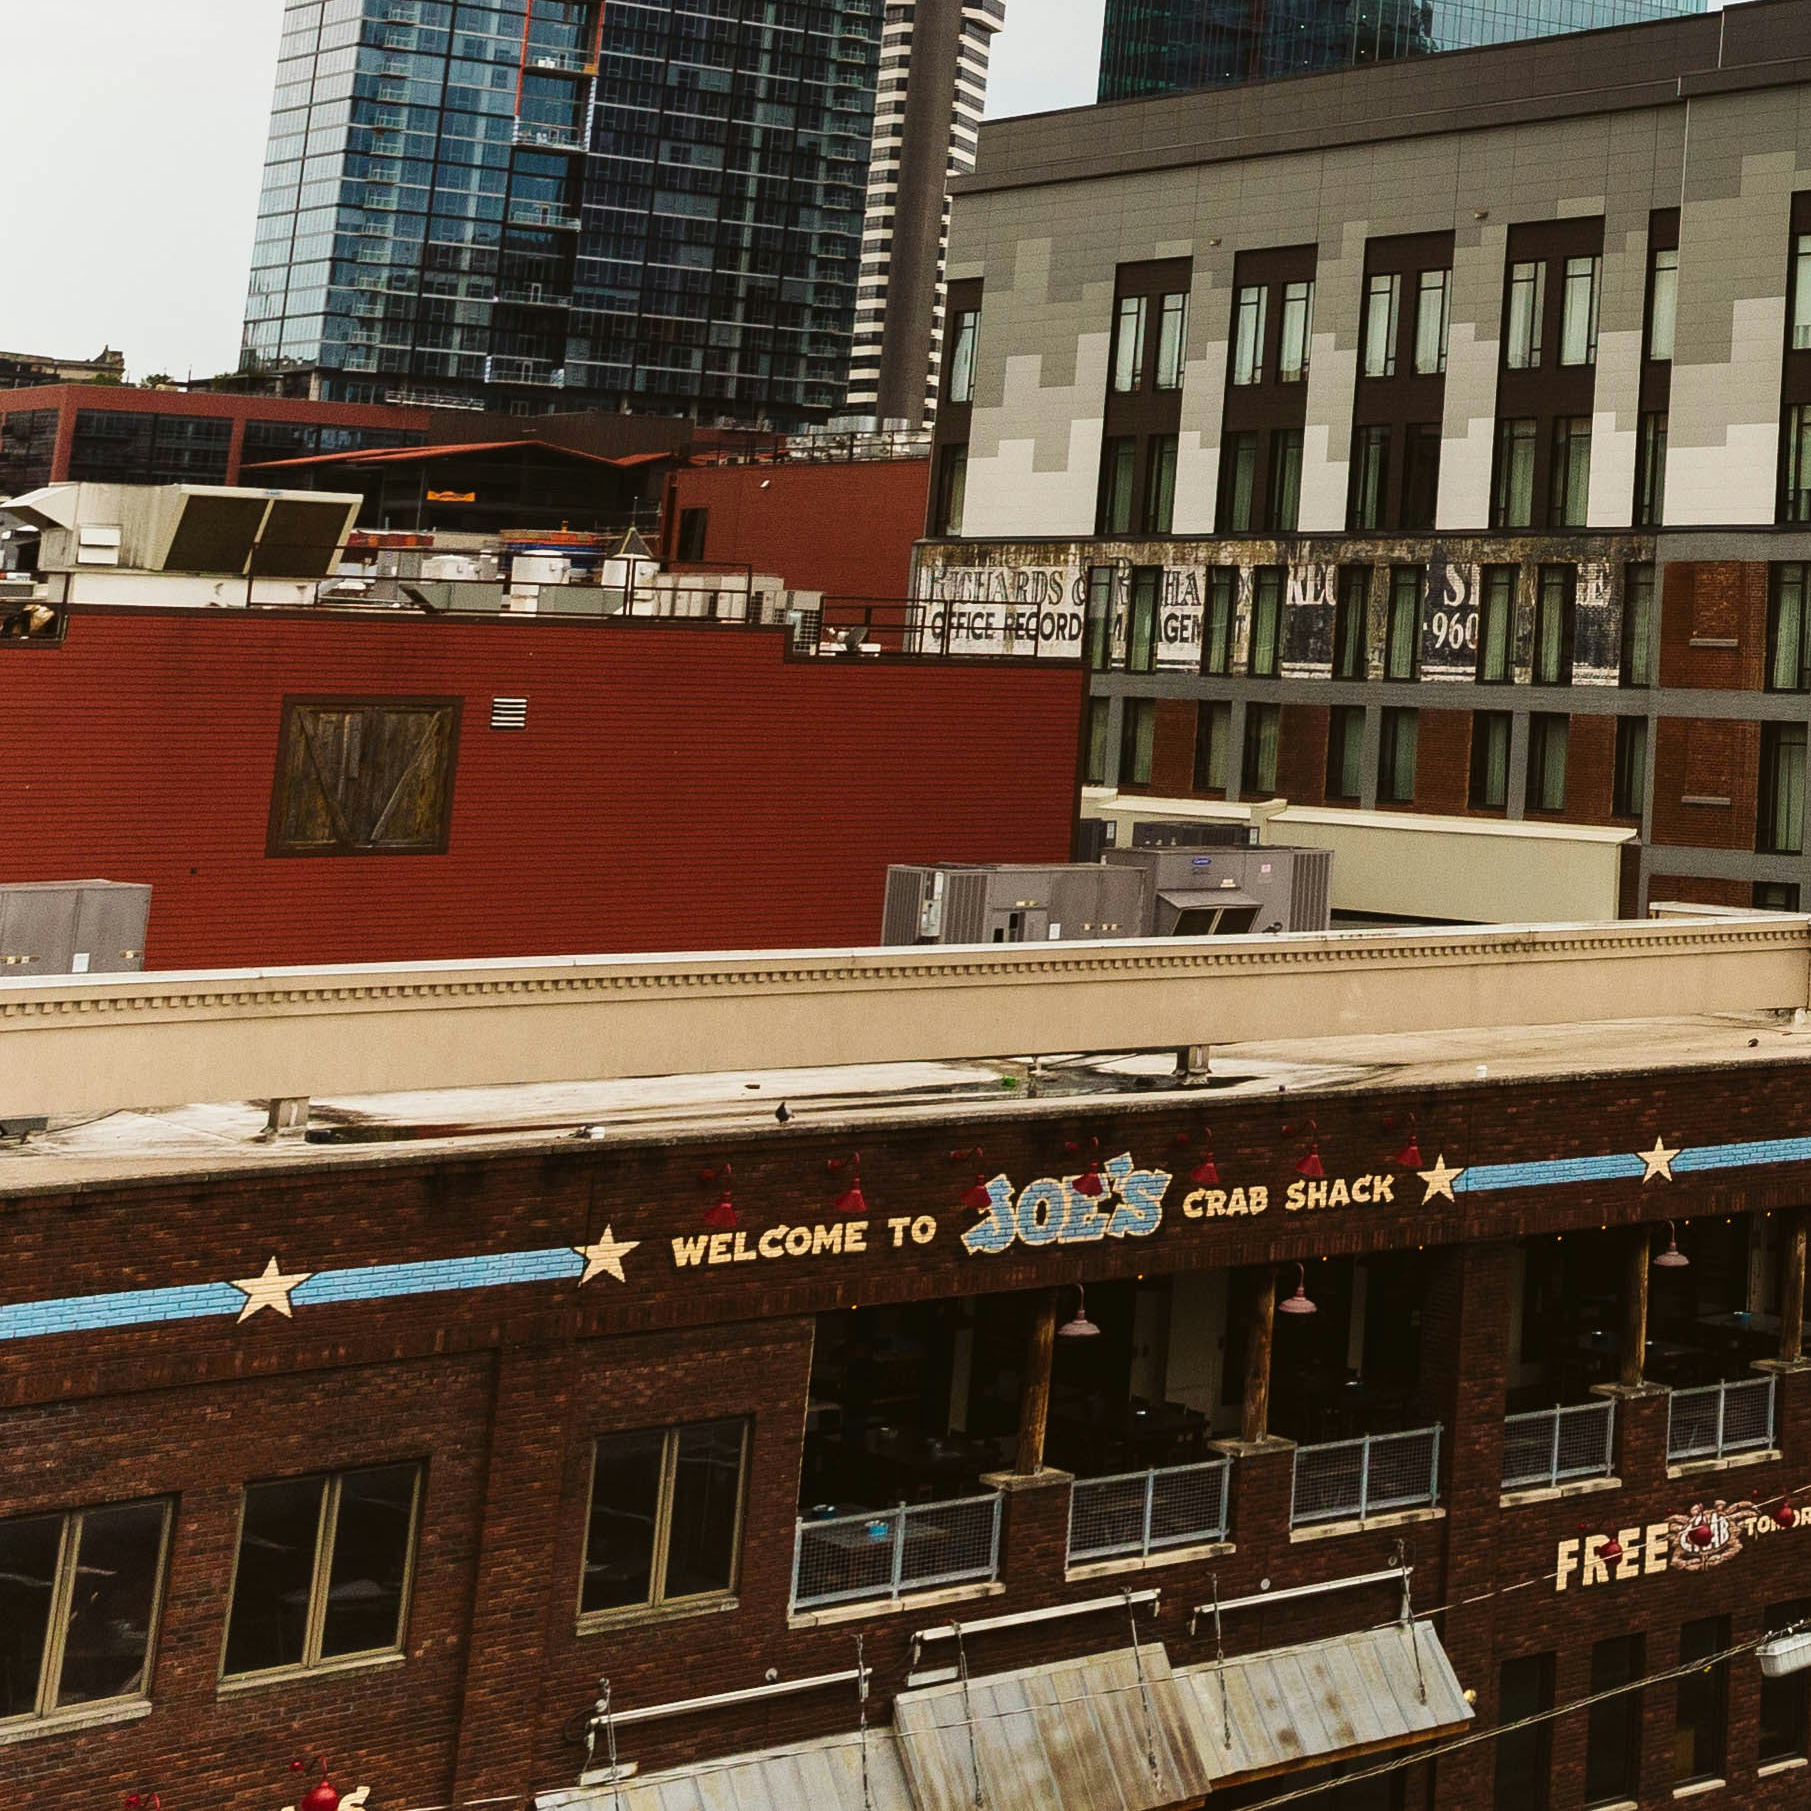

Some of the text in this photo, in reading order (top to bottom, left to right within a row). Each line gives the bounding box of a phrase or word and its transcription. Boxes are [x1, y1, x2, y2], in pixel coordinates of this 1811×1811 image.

[931, 560, 1063, 606] RICHARDS
[671, 1151, 1395, 1268] WELCOME TO JOE'S CRAB SHACK
[1555, 1523, 1670, 1591] FREE
[1680, 1512, 1730, 1553] CAB
